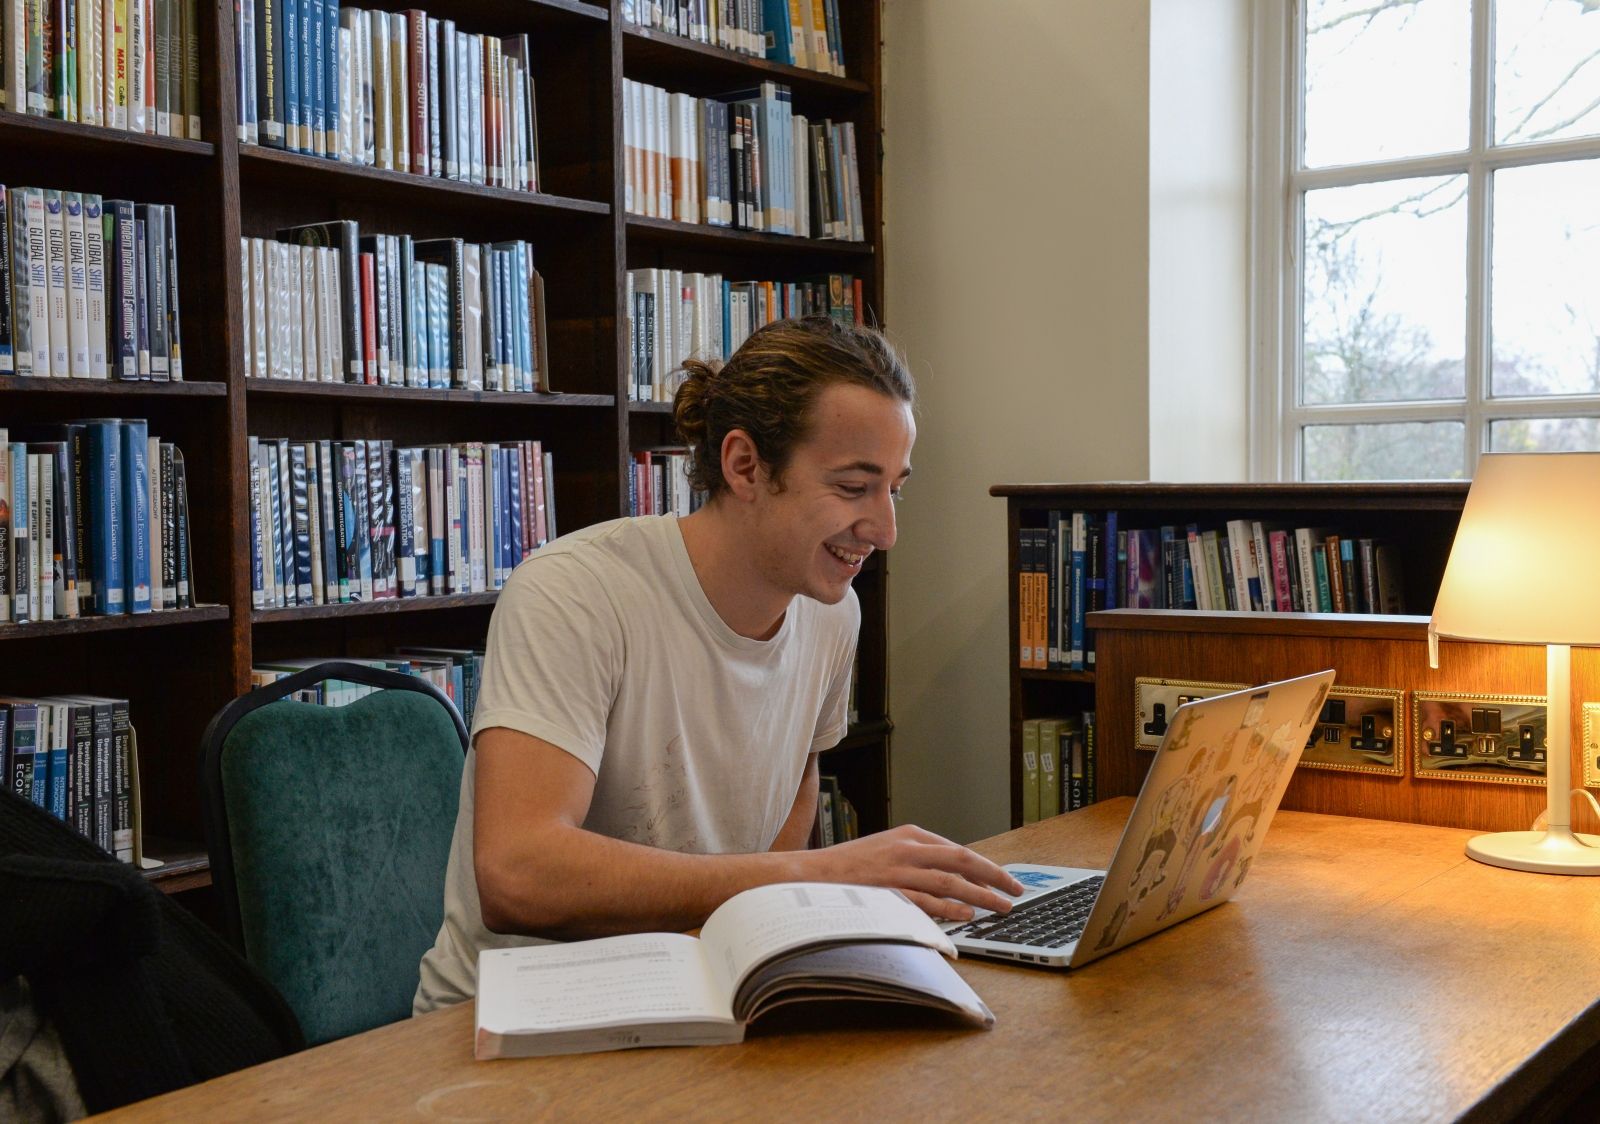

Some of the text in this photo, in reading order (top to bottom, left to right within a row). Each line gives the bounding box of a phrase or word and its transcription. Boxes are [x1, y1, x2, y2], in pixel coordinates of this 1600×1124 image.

[157, 35, 169, 82] AUSTERITY
[171, 35, 182, 81] AUSTERITY
[188, 34, 200, 81] AUSTERITY
[417, 82, 425, 118] SOUTH
[30, 228, 42, 262] GLOBAL
[50, 229, 62, 263] GLOBAL
[70, 231, 84, 290] GLOBAL SHIFT
[88, 233, 102, 293] GLOBAL SHIFT
[32, 264, 45, 288] SHIFT
[52, 266, 64, 288] SHIFT
[121, 219, 135, 340] Modern International Economics
[456, 291, 463, 300] TO
[136, 470, 144, 521] International
[76, 528, 84, 565] Economy
[1234, 549, 1243, 580] ECONOMICS
